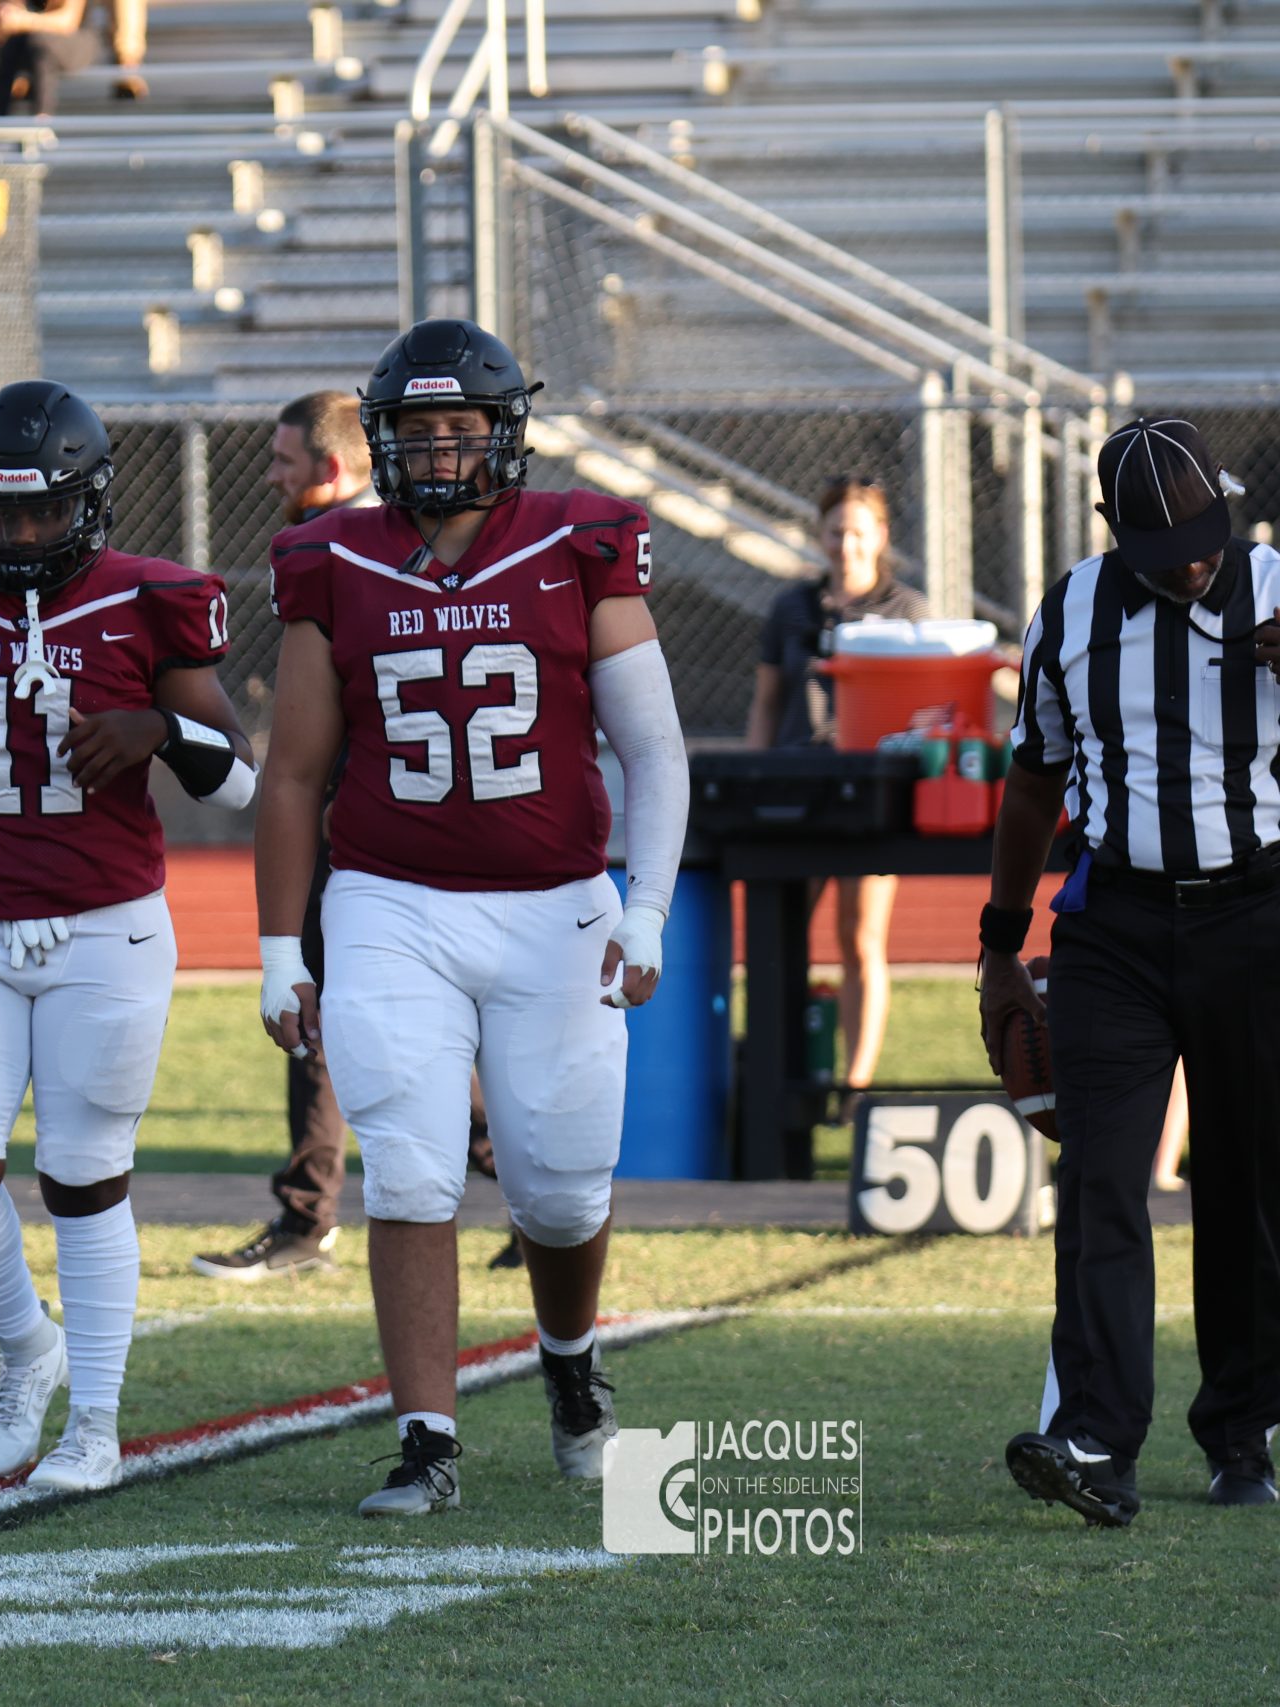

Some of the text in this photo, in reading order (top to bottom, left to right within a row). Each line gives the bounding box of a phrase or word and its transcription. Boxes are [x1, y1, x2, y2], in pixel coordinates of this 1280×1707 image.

[410, 380, 454, 390] Riddell
[388, 603, 510, 636] RED WOLVES
[9, 641, 83, 671] WVES
[373, 643, 542, 803] 52
[857, 1102, 1027, 1234] 50
